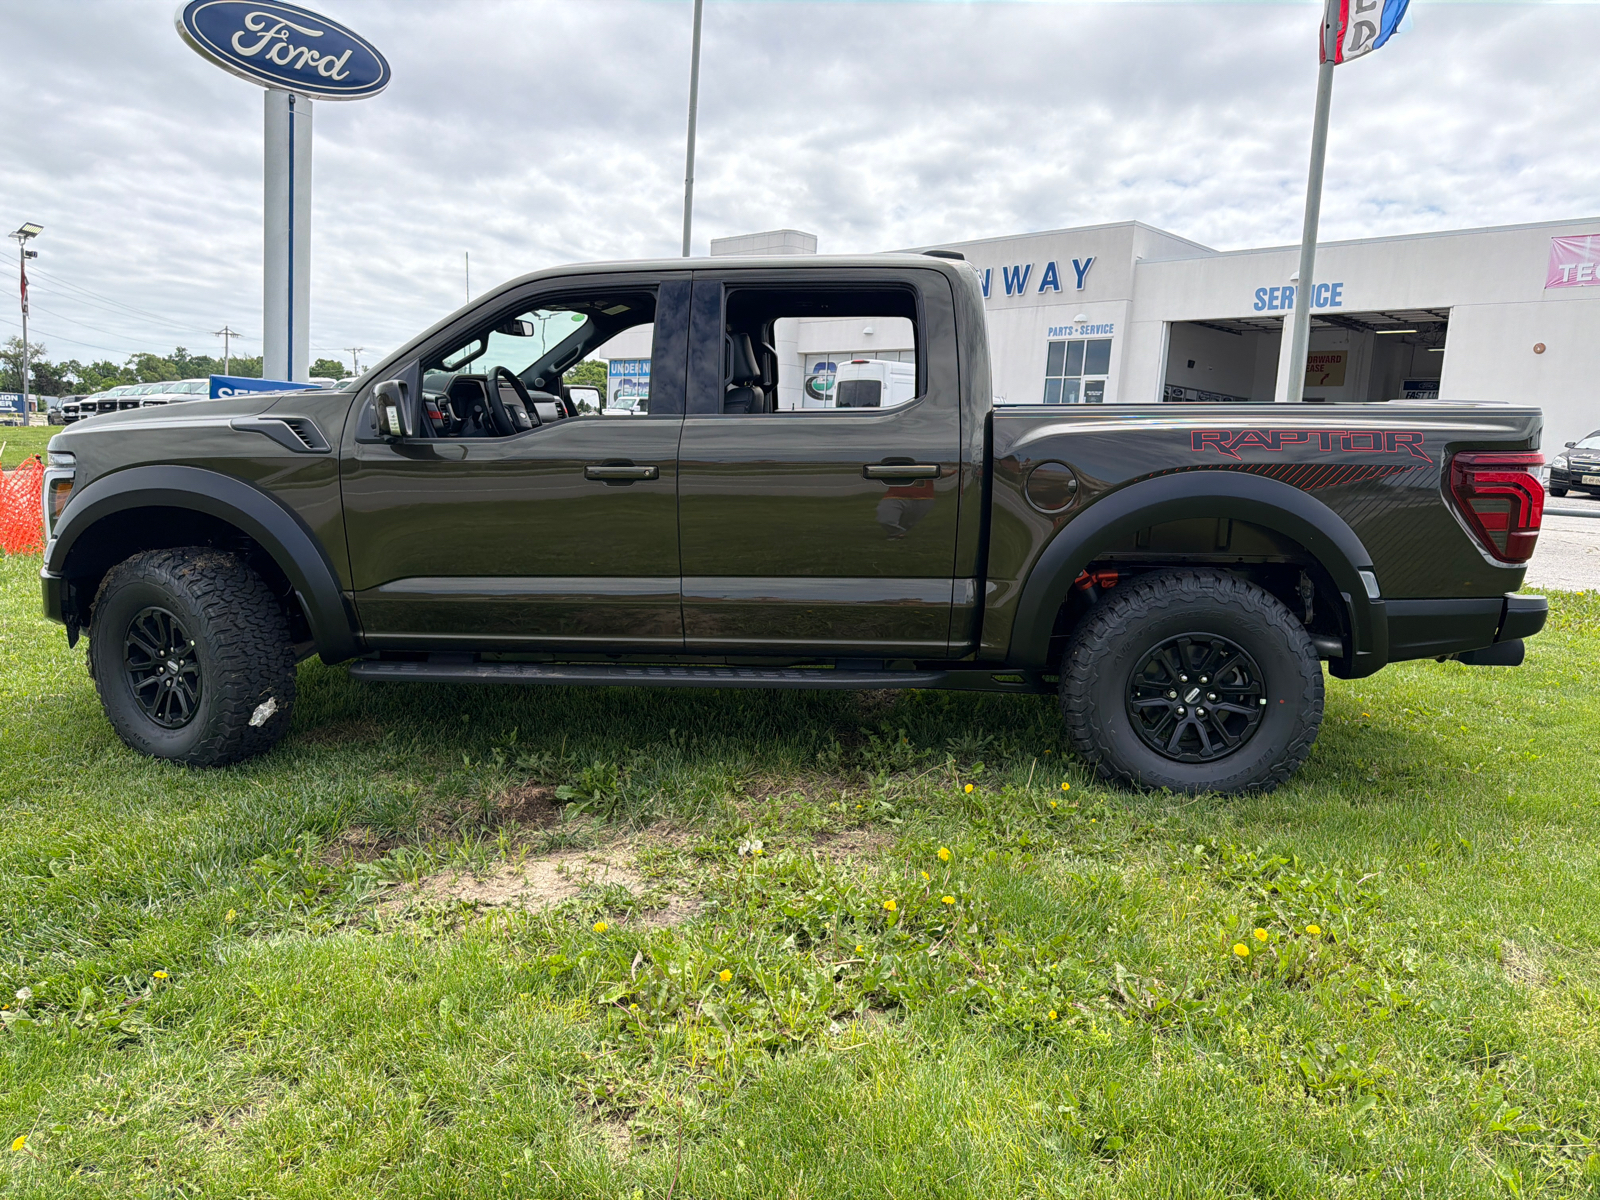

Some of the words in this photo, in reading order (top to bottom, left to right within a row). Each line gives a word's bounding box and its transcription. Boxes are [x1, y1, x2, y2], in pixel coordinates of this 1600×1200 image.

[231, 11, 353, 81] Ford
[1559, 263, 1600, 283] TE
[1254, 282, 1343, 311] SERICE
[1048, 326, 1073, 337] PARTS
[1080, 323, 1114, 335] SERVICE
[611, 362, 641, 373] UNDER
[1191, 430, 1433, 463] RAPTOR
